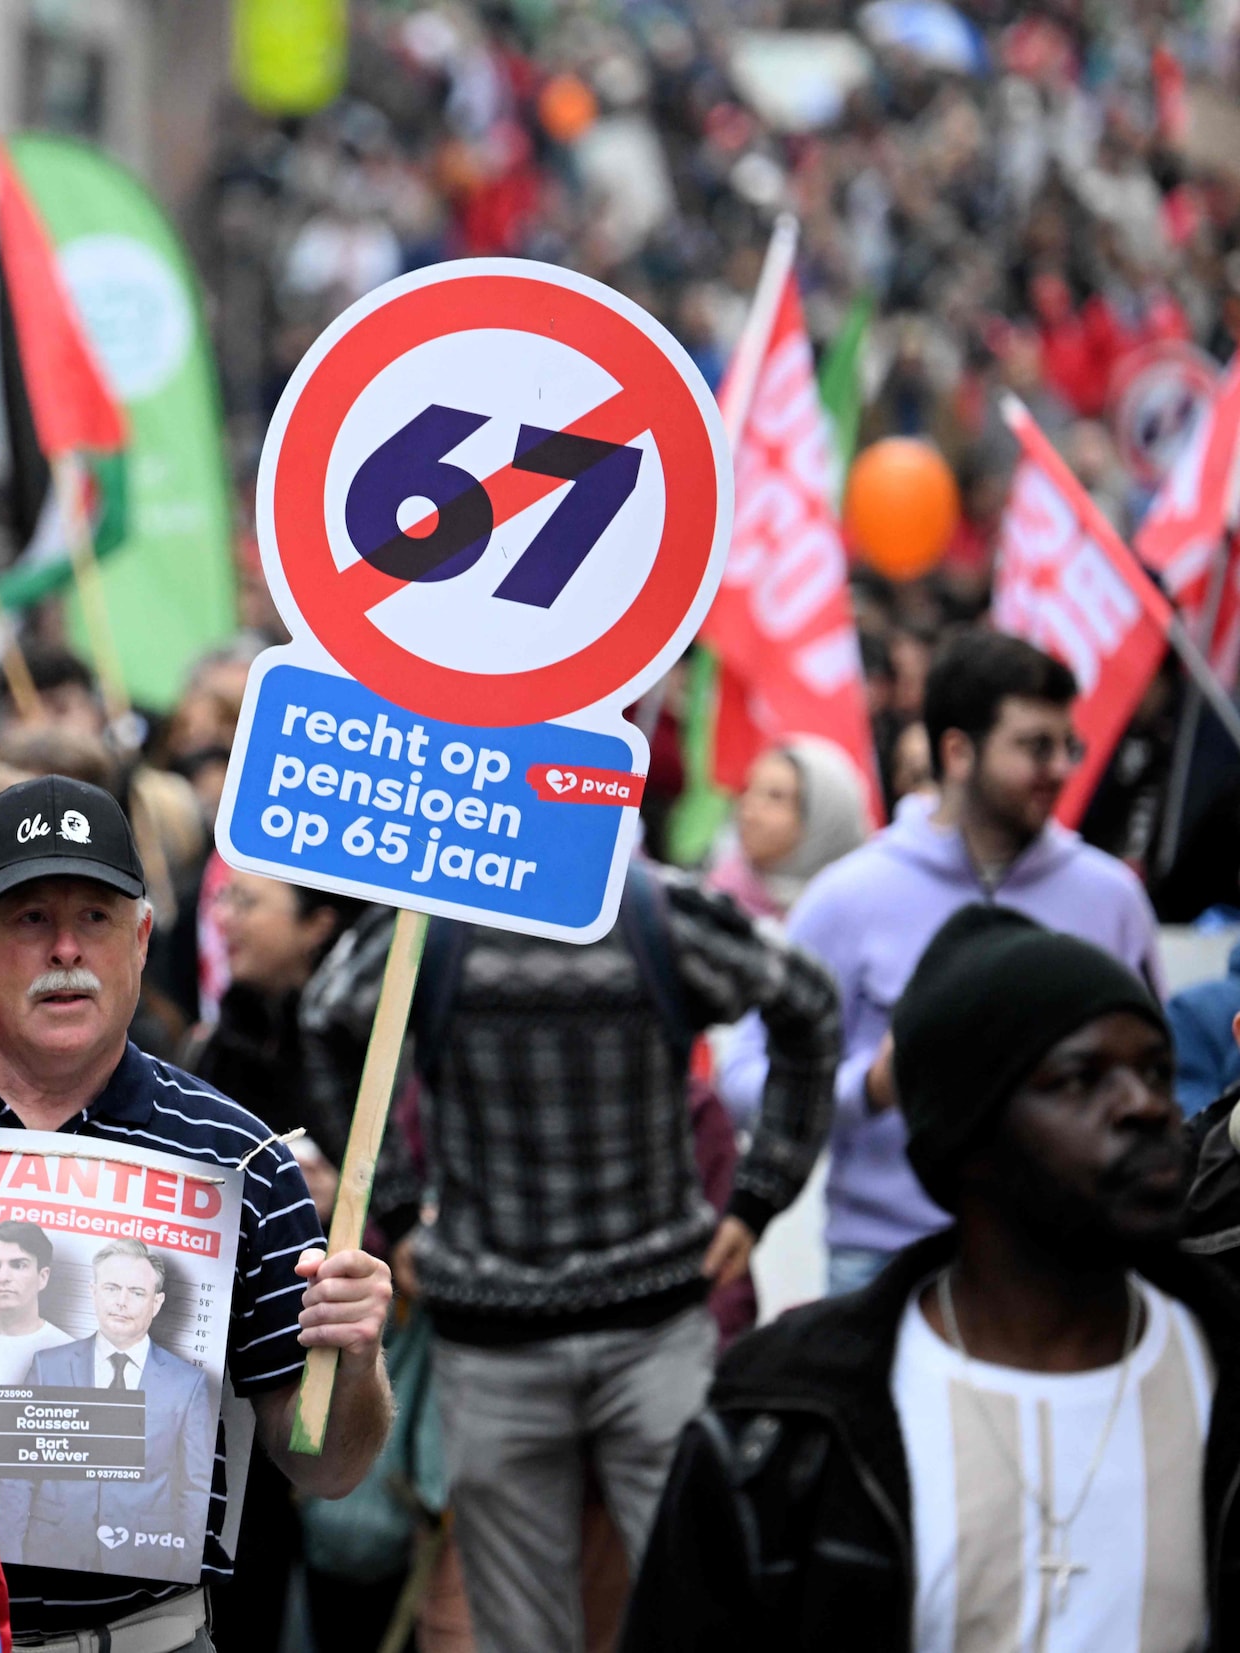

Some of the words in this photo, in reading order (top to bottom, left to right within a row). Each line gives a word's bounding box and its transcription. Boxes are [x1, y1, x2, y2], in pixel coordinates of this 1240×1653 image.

[345, 403, 644, 609] 67
[281, 704, 430, 767] recht
[441, 740, 510, 790] op
[268, 753, 521, 839] pensioen
[581, 777, 630, 799] pvda
[17, 813, 51, 843] Che
[260, 804, 329, 854] op
[341, 816, 411, 865] 65
[410, 827, 537, 892] jaar
[11, 1205, 212, 1252] pensioendiefstal
[24, 1405, 79, 1418] Conner
[16, 1417, 90, 1430] Rousseau
[35, 1437, 69, 1450] Bart
[18, 1449, 38, 1461] De
[42, 1449, 89, 1462] Wever
[86, 1470, 96, 1478] ID
[97, 1470, 141, 1479] 93775240
[134, 1532, 185, 1549] pvda
